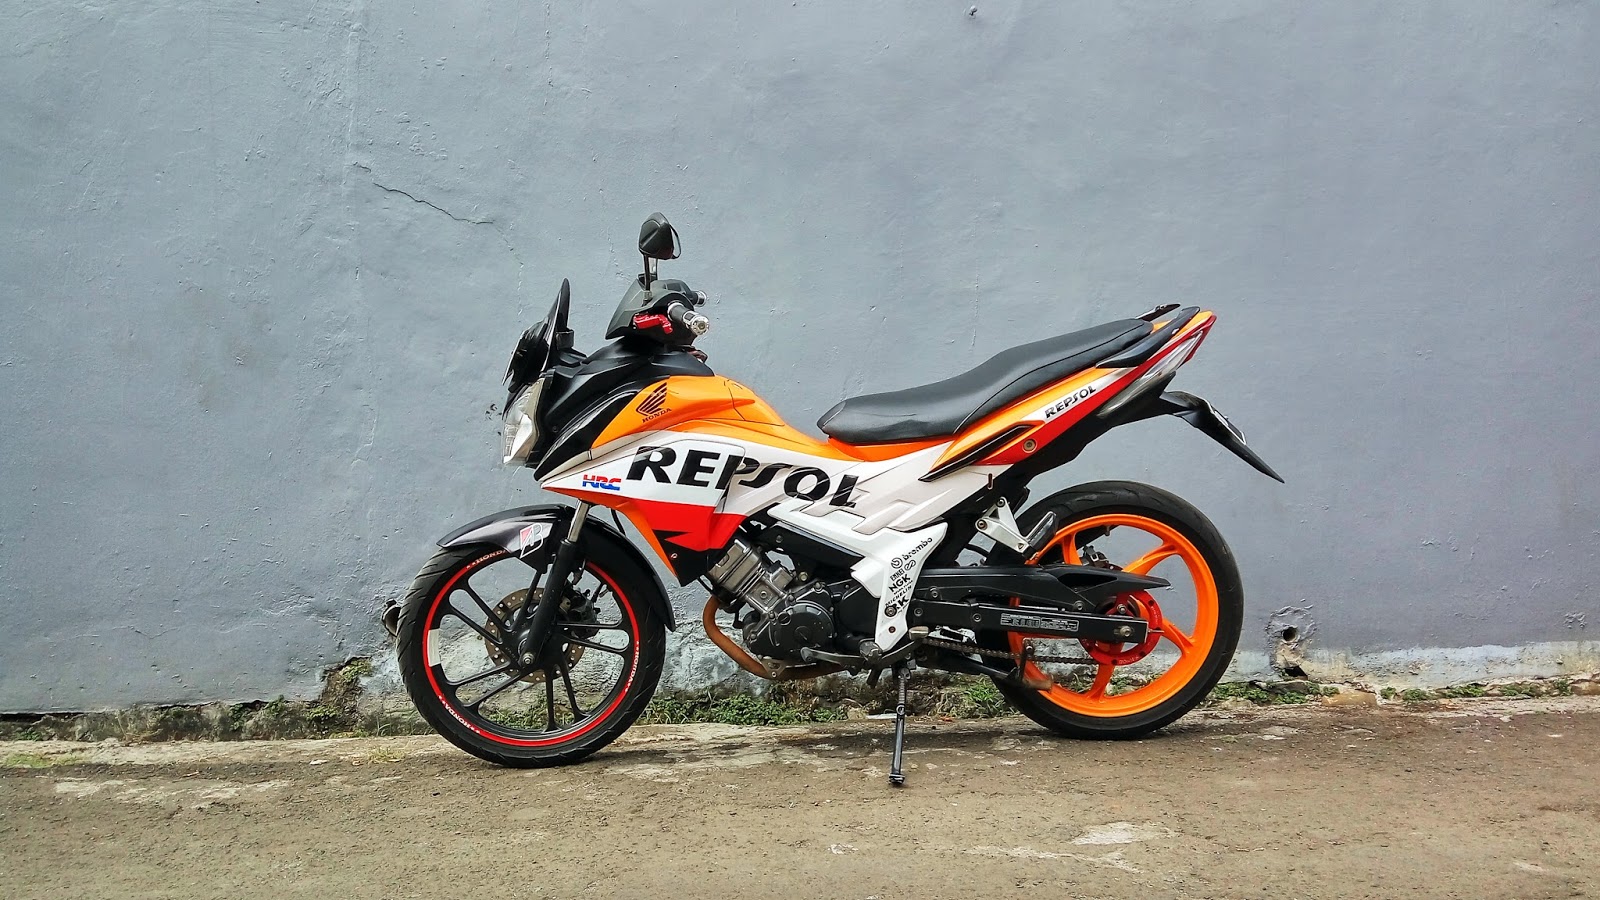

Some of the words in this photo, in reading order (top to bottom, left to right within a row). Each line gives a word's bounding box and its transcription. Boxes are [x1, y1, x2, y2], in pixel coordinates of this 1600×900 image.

[1044, 385, 1097, 419] REPSOL
[642, 407, 672, 424] HONDA
[582, 474, 622, 491] HRC
[626, 445, 860, 508] REPSOL
[902, 537, 933, 560] brembo
[889, 573, 911, 592] NGK
[445, 703, 471, 728] HONDA
